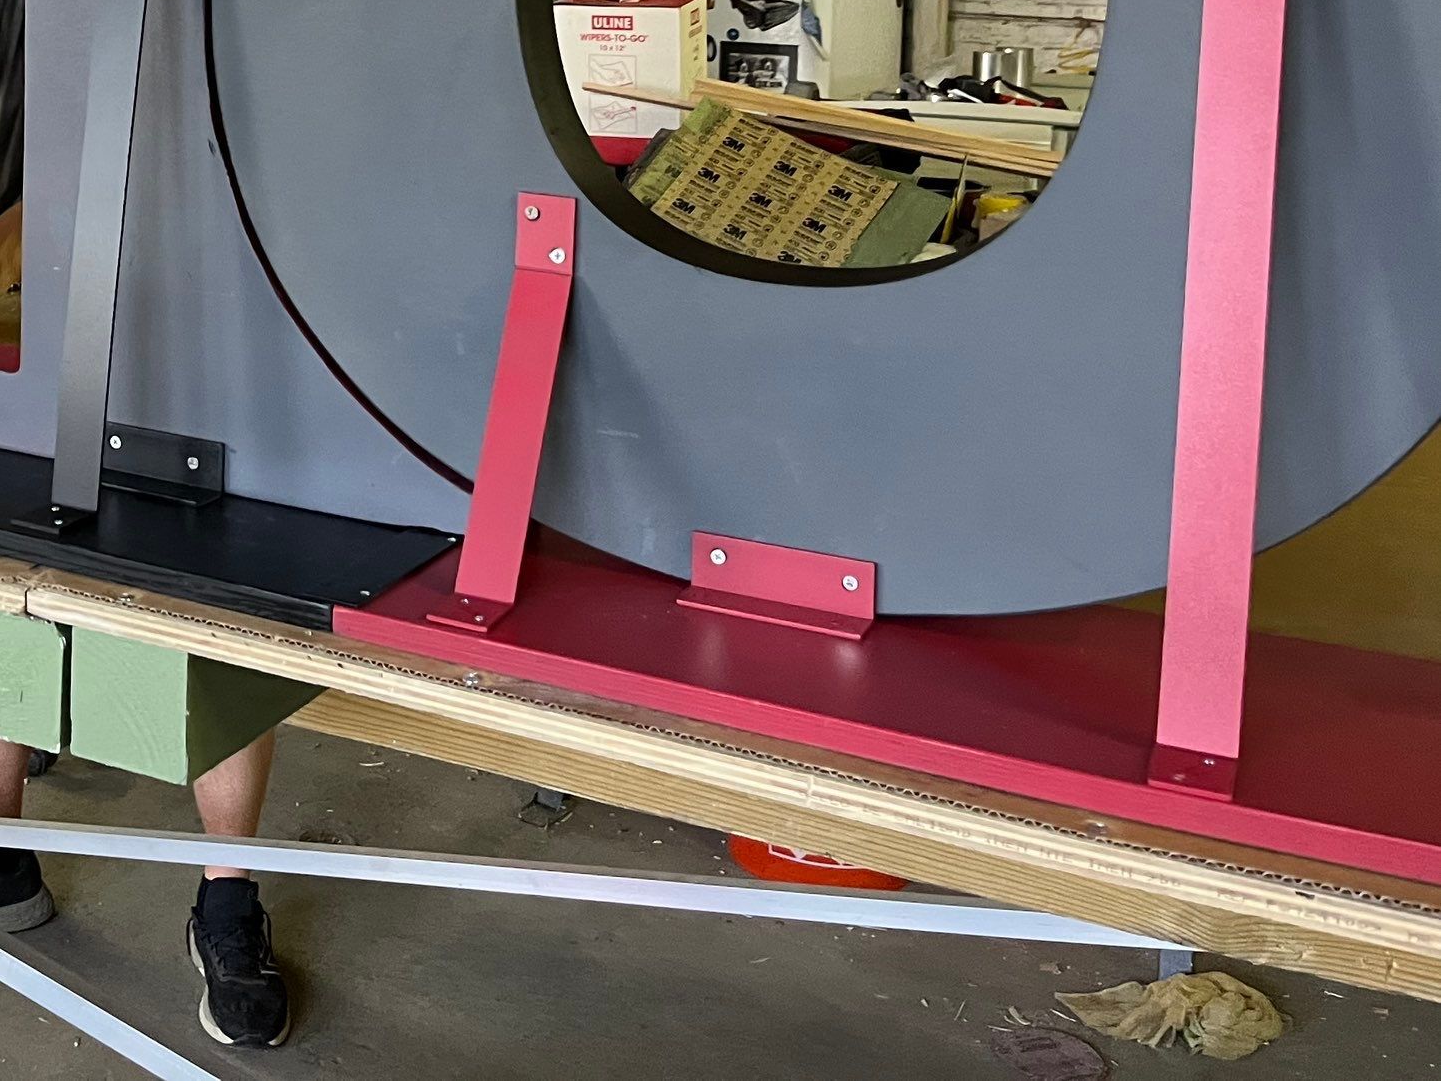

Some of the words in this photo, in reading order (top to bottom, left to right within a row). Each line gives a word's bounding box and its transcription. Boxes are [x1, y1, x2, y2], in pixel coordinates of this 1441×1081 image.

[593, 17, 631, 29] ULINE
[722, 136, 745, 152] 3M
[697, 167, 721, 183] 3M
[774, 160, 798, 177] 3M
[749, 192, 773, 208] 3M
[827, 185, 853, 202] 3M
[672, 198, 696, 215] 3M
[723, 223, 747, 241] 3M
[802, 217, 827, 233] 3M
